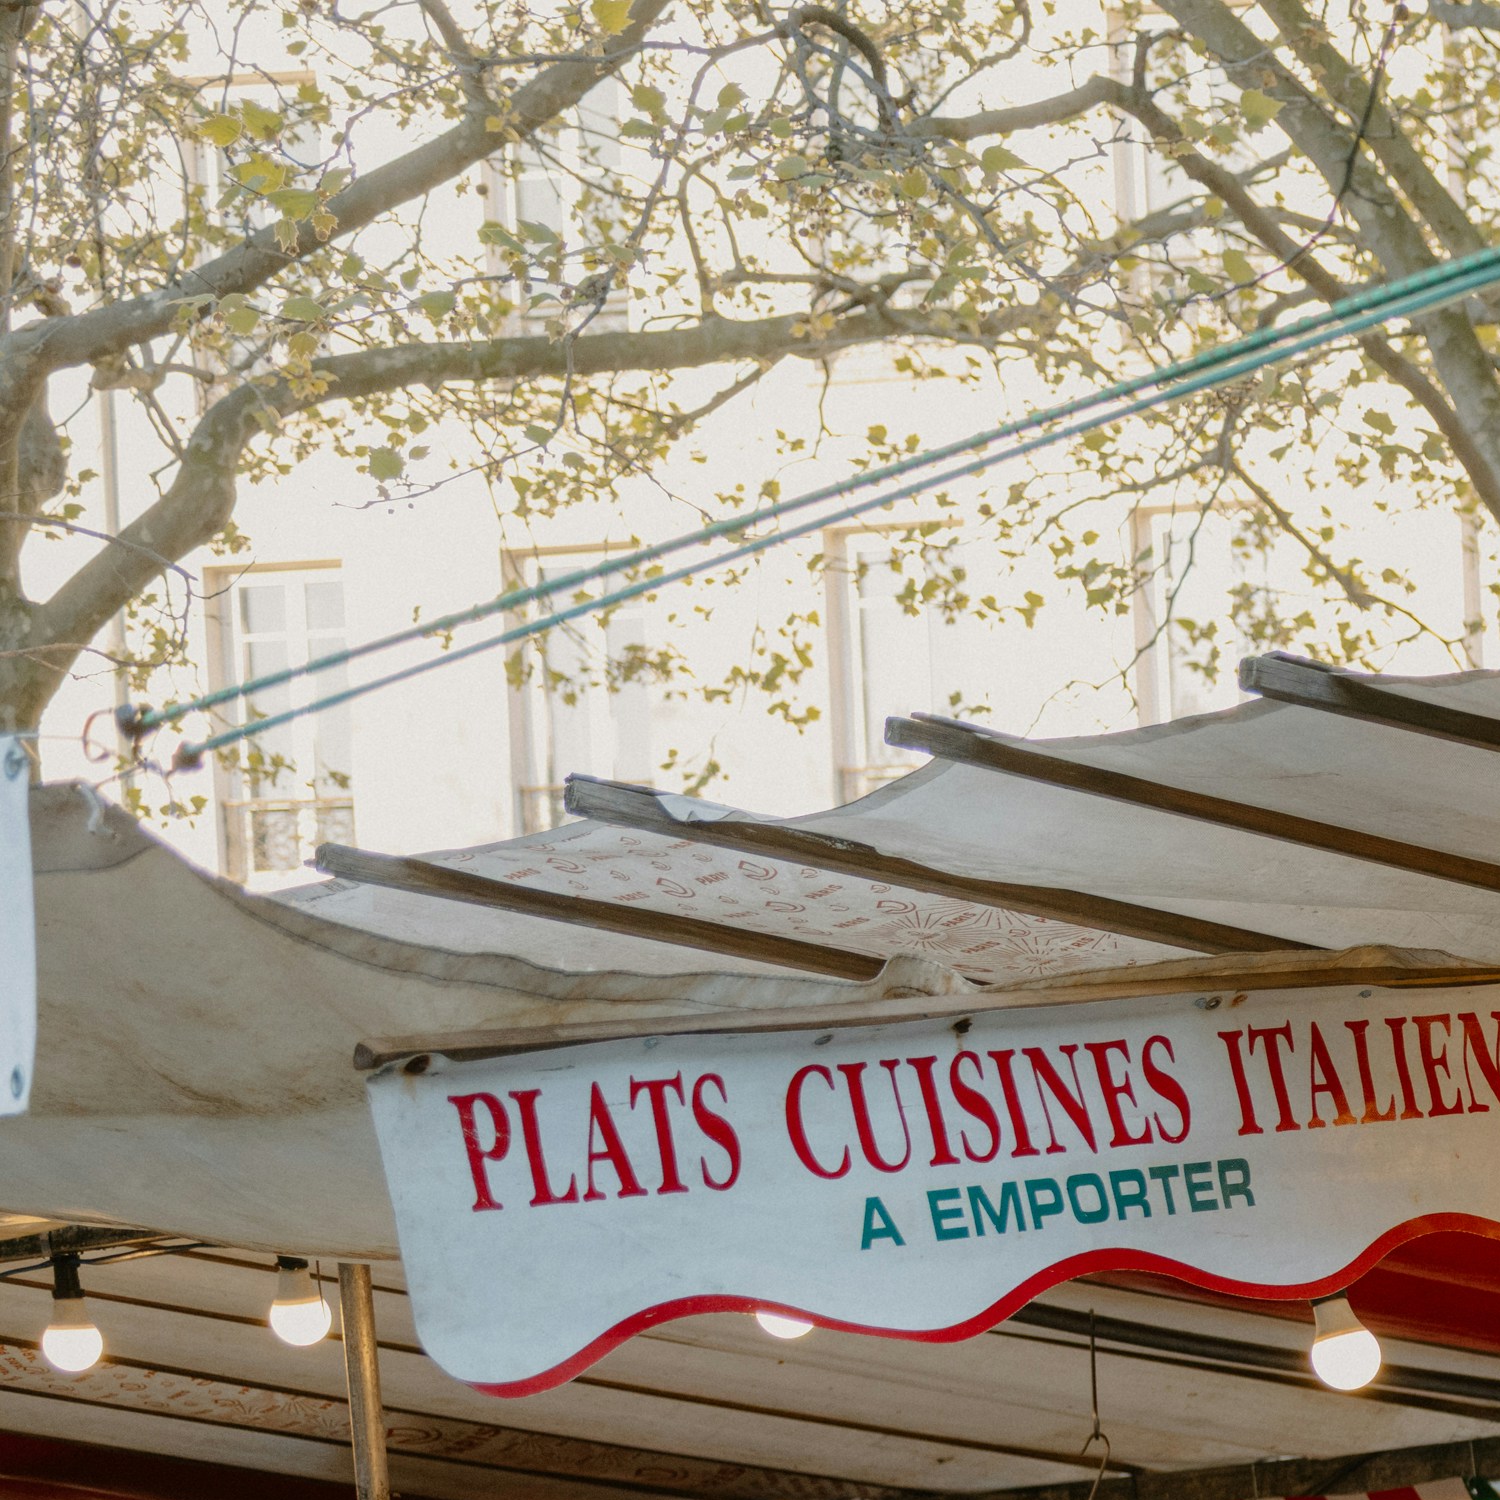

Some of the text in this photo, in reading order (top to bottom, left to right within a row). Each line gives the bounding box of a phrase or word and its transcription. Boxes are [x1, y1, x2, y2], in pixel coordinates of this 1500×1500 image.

[446, 1070, 743, 1213] PLATS
[785, 1032, 1193, 1181] CUISINES
[860, 1157, 1256, 1251] A EMPORTER
